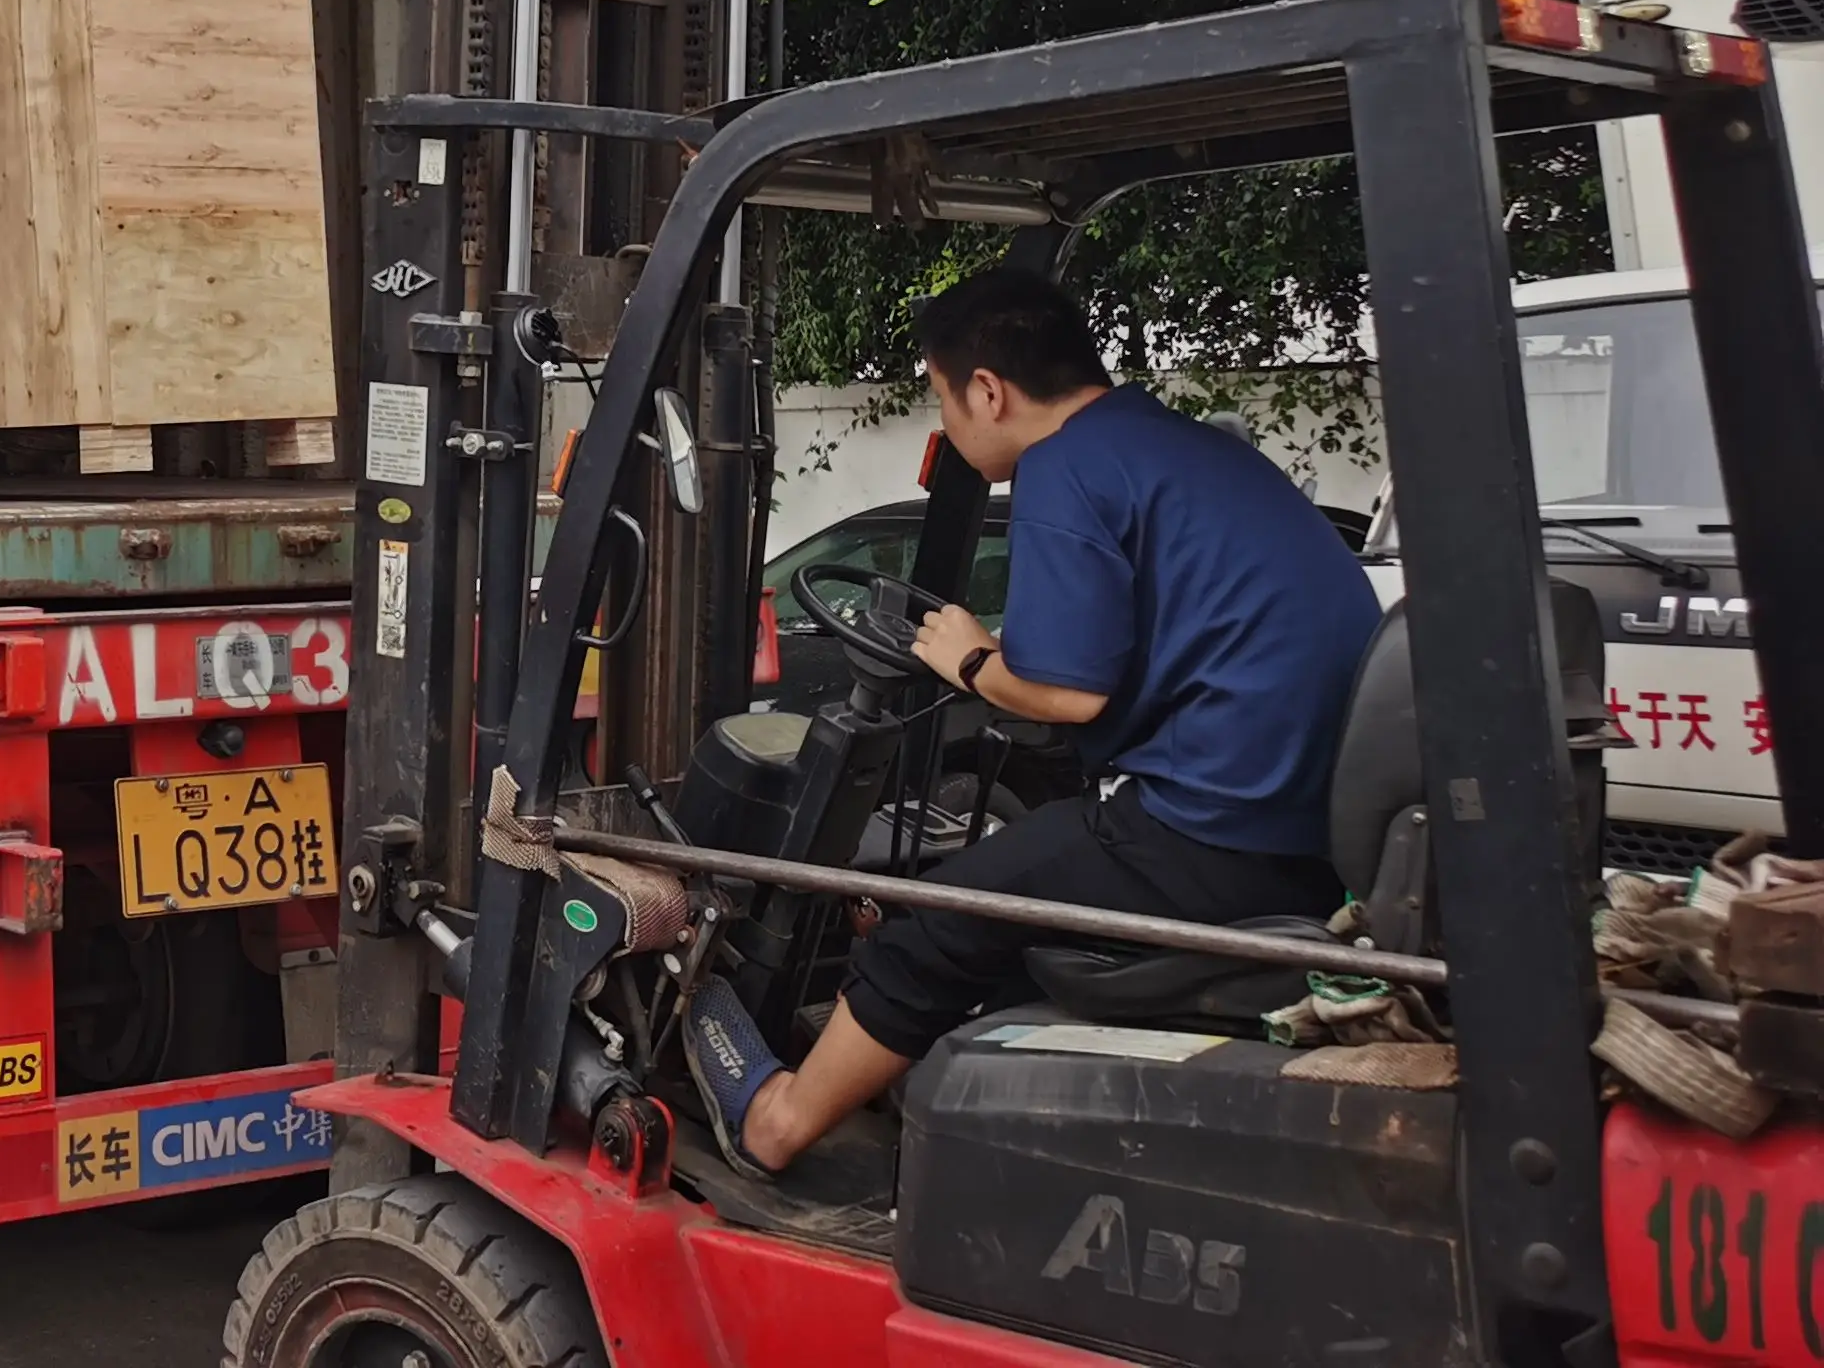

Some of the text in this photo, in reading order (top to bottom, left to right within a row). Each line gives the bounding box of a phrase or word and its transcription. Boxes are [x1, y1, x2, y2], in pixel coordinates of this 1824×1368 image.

[133, 819, 327, 905] LQ38挂
[65, 1127, 132, 1188] 长车
[152, 1112, 266, 1167] CIMC
